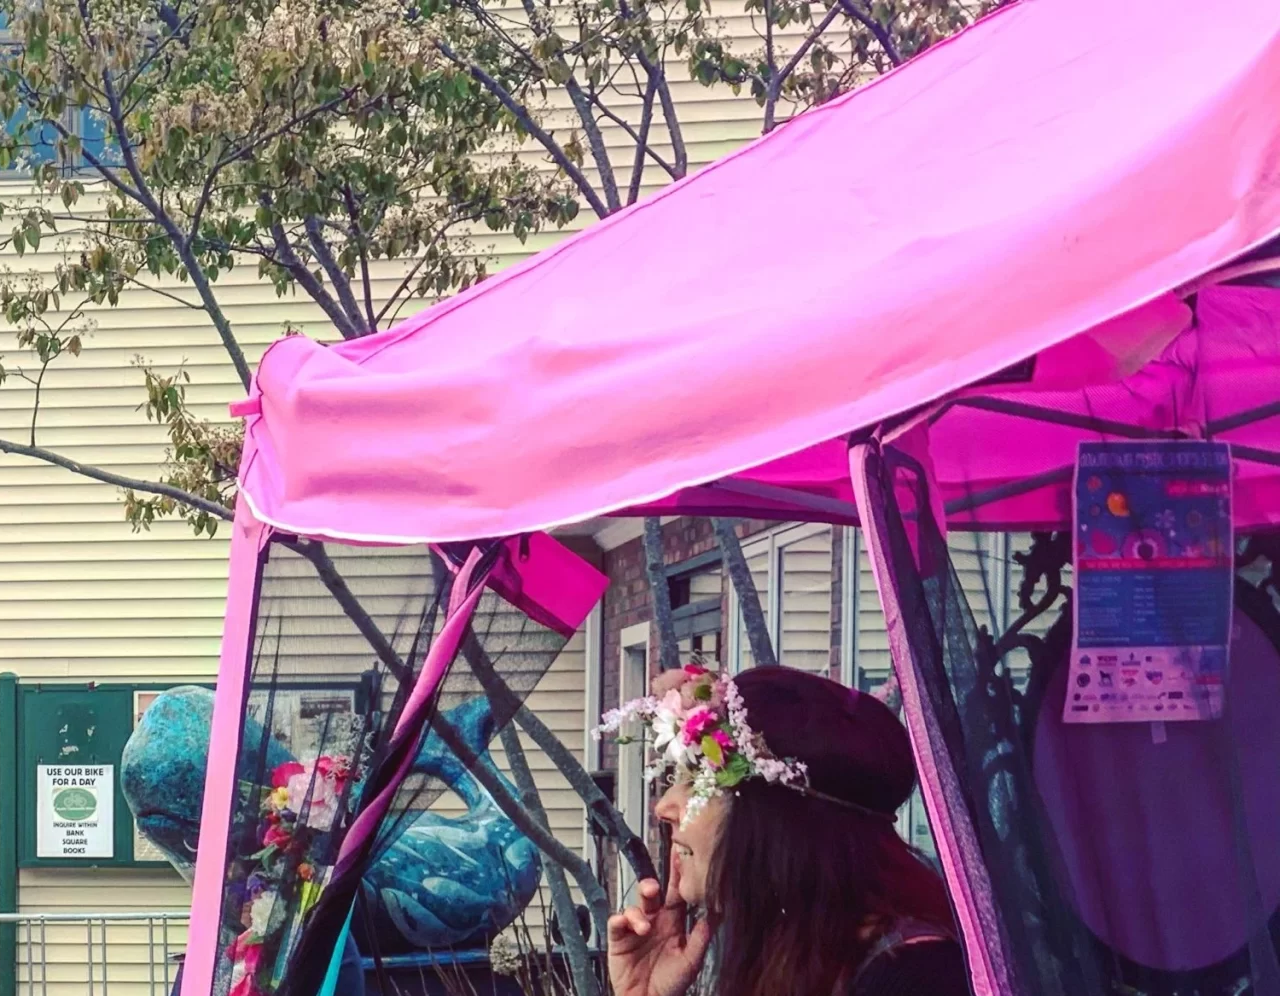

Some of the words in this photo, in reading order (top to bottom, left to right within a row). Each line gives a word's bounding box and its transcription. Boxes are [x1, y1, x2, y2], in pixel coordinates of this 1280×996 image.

[46, 768, 62, 776] USE
[64, 768, 82, 776] OUR
[85, 768, 104, 776] BIKE
[52, 778, 69, 786] FOR
[71, 778, 77, 786] A
[79, 778, 96, 786] DAY
